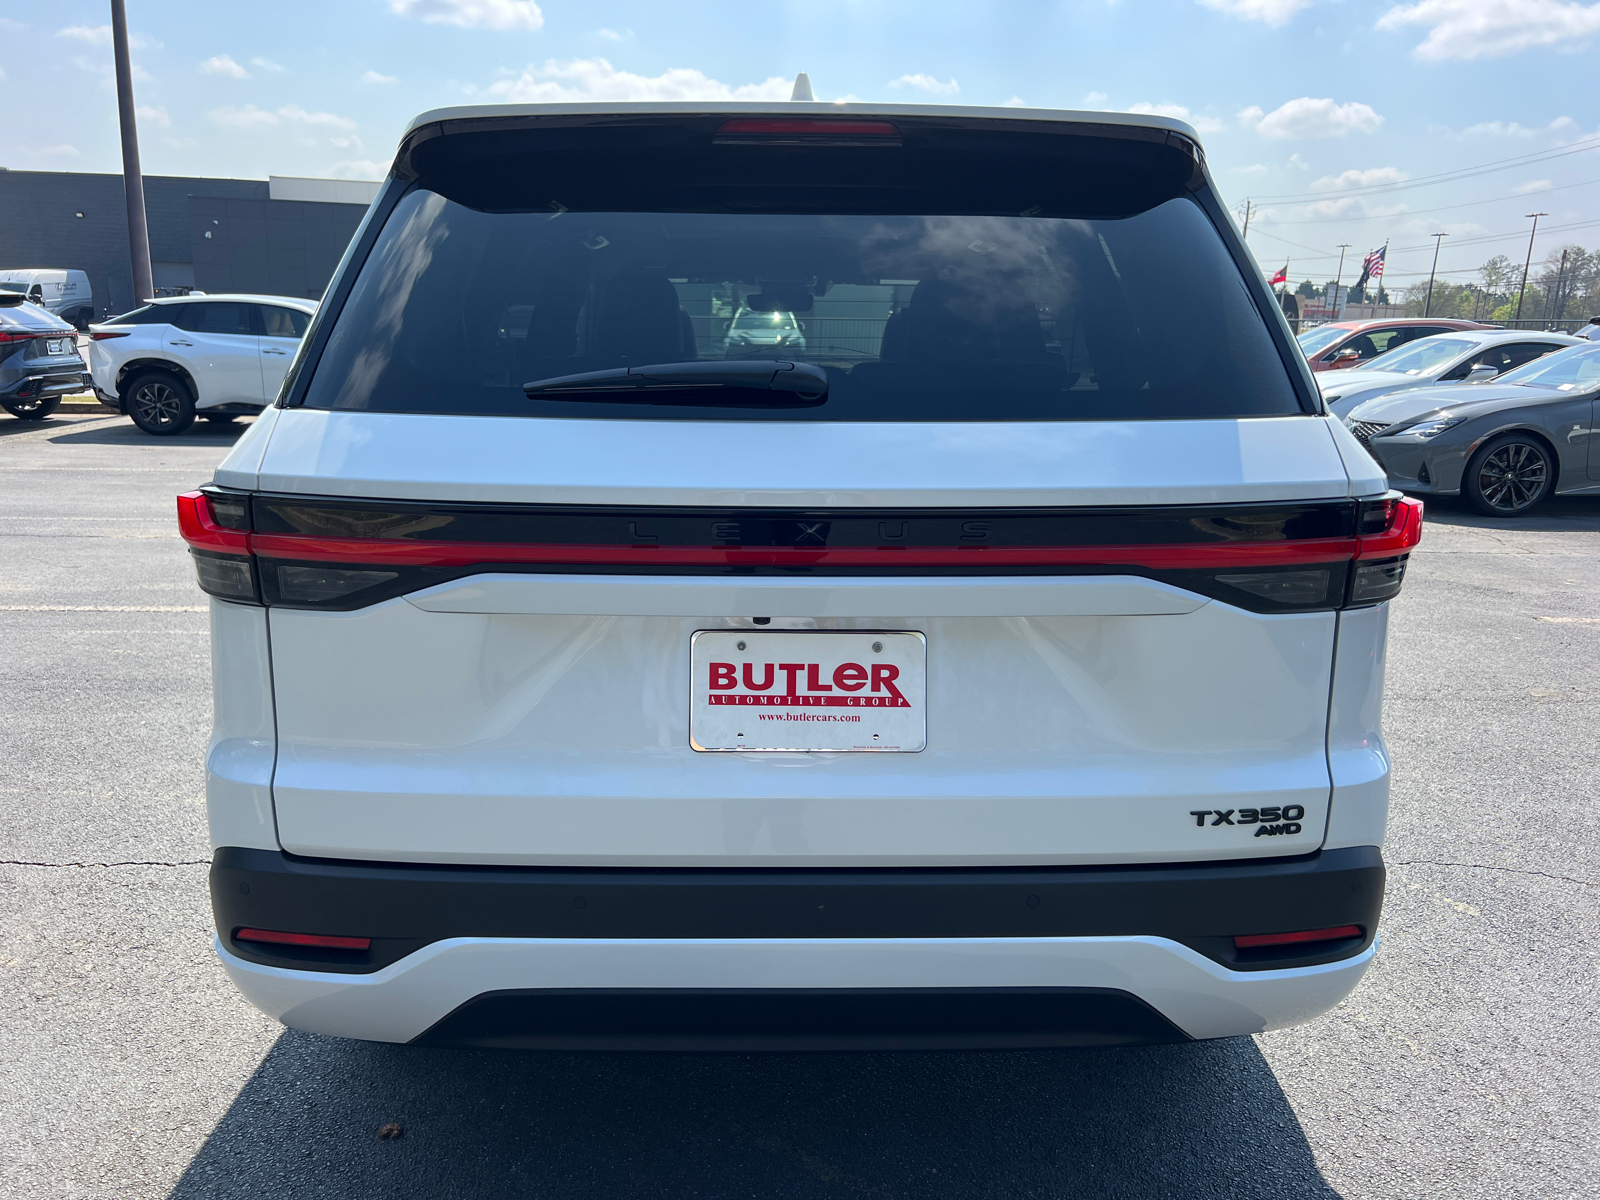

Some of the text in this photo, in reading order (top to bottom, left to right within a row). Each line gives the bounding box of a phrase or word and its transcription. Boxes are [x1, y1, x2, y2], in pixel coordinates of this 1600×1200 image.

[628, 521, 993, 542] LEXUS
[709, 696, 904, 706] AUTOMOTIVE GROUP
[758, 712, 861, 723] www.butlercars.com
[1254, 822, 1302, 838] AWD
